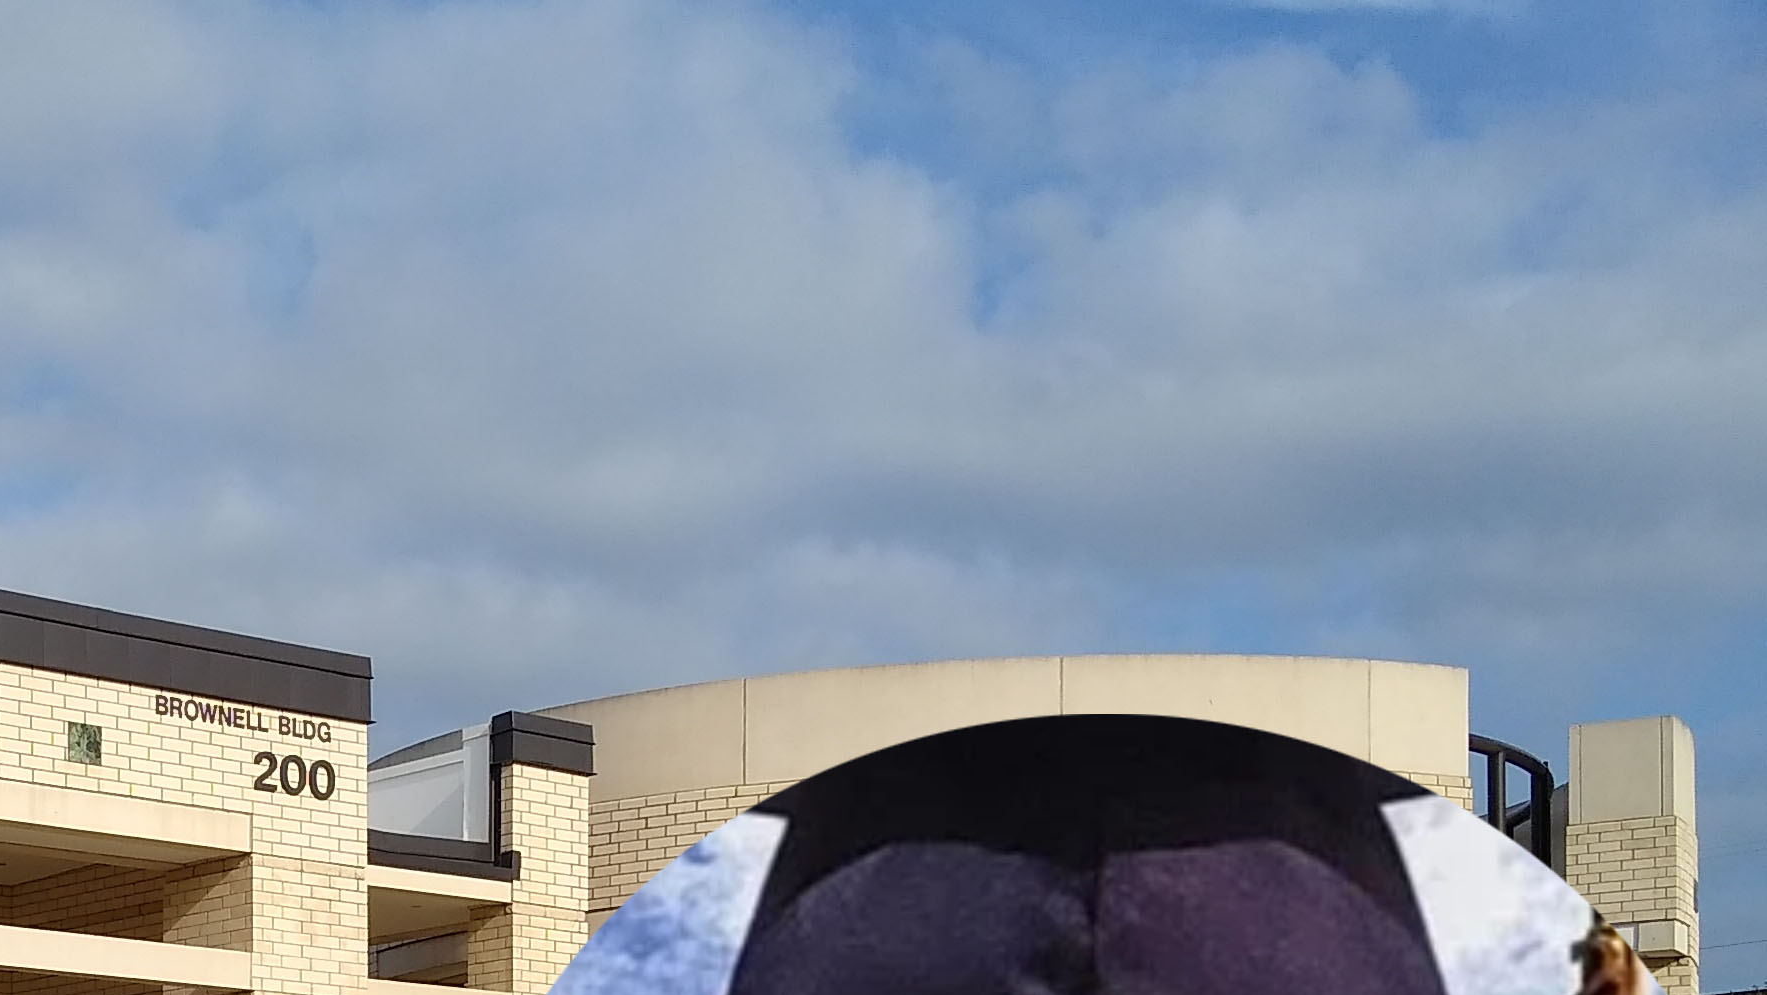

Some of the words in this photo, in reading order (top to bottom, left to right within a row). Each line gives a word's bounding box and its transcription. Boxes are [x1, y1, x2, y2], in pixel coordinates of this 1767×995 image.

[155, 695, 268, 733] BROWNELL
[278, 715, 332, 743] BLDG
[253, 751, 335, 801] 200
